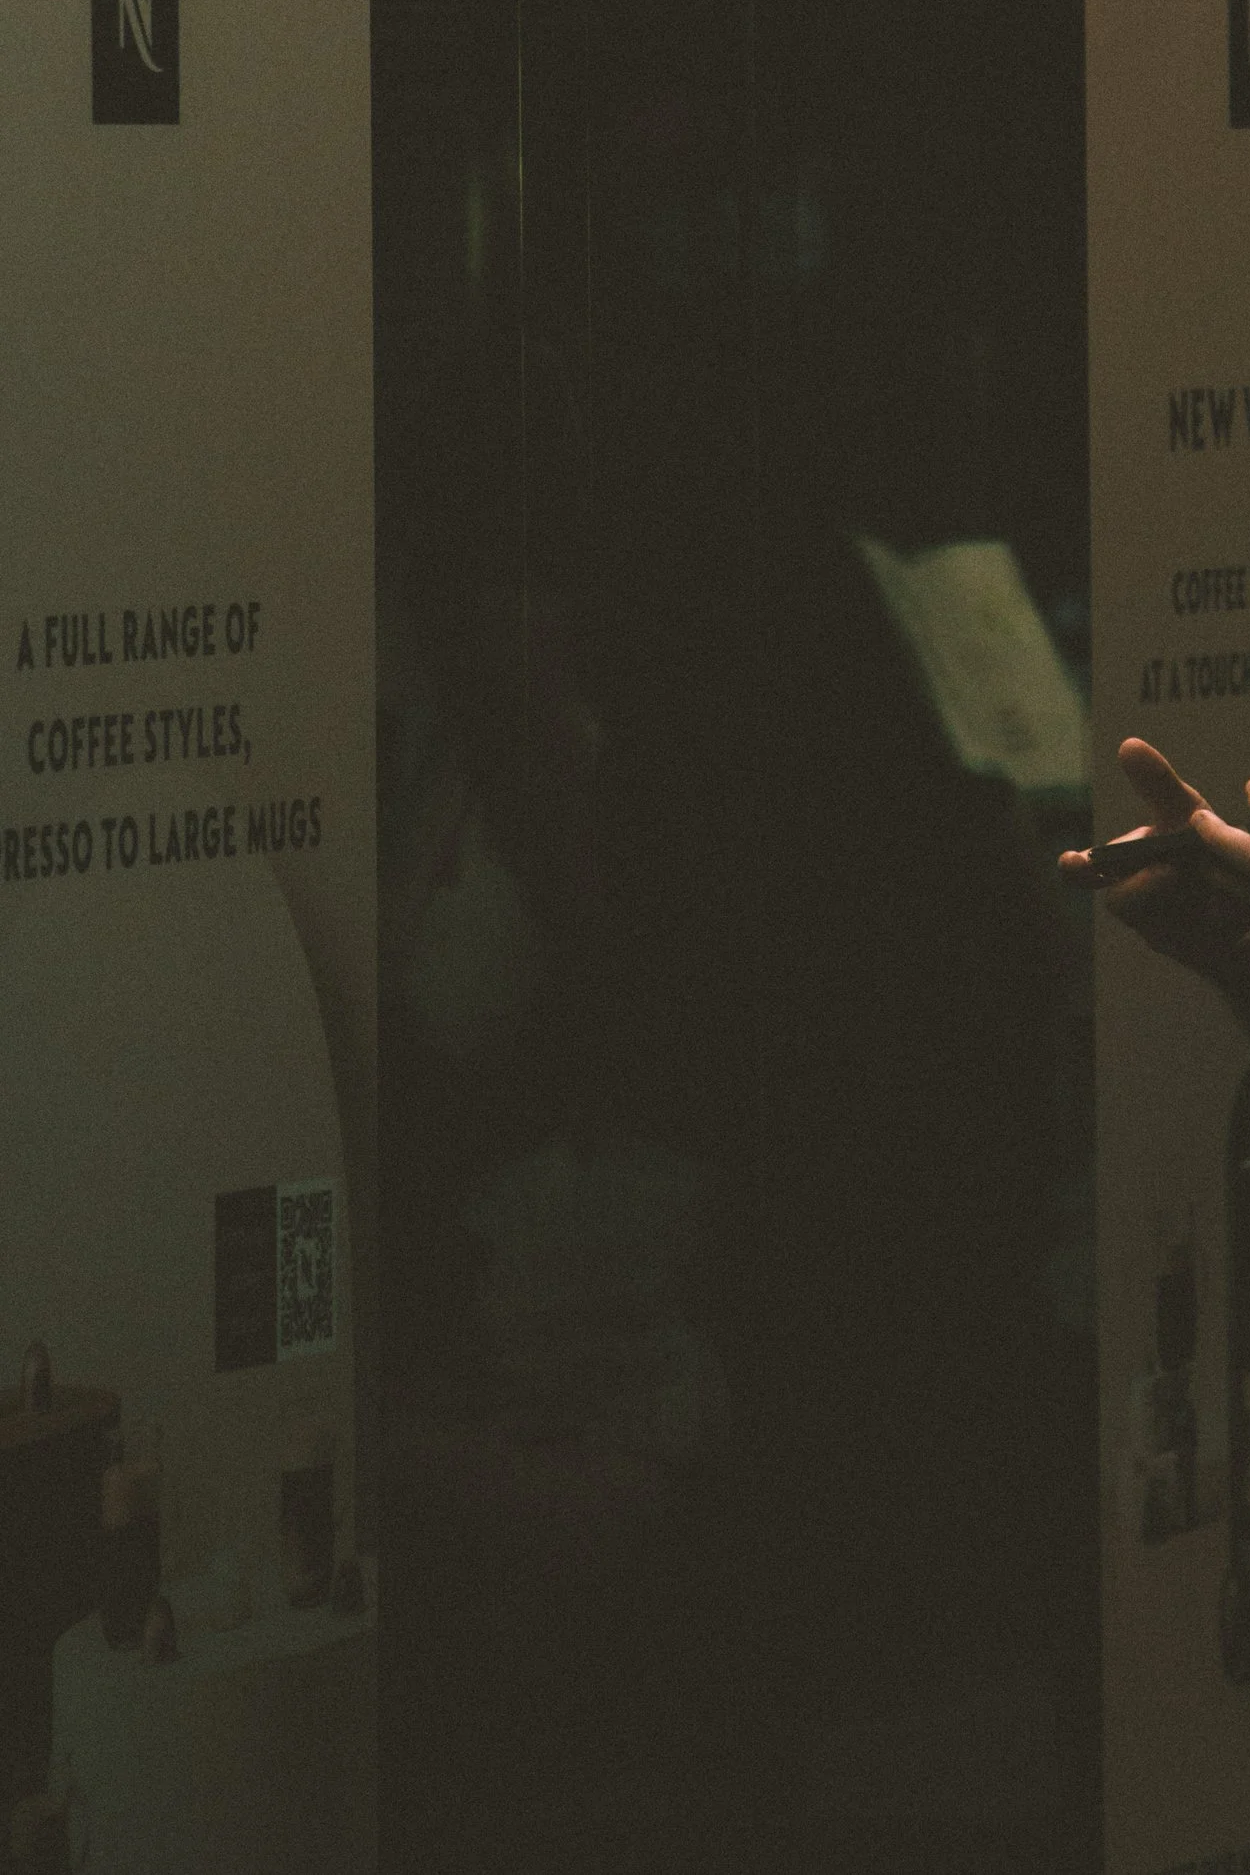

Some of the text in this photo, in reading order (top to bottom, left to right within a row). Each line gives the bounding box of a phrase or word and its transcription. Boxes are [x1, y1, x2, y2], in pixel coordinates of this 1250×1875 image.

[1167, 386, 1237, 453] NEW
[1171, 567, 1247, 617] COFFEE
[16, 601, 261, 672] A FULL RANGE OF
[1139, 659, 1164, 705] AT
[1168, 660, 1182, 703] A
[27, 703, 252, 775] COFFEE STYLES,
[0, 796, 322, 882] RESSO TO LARGE MUGS
